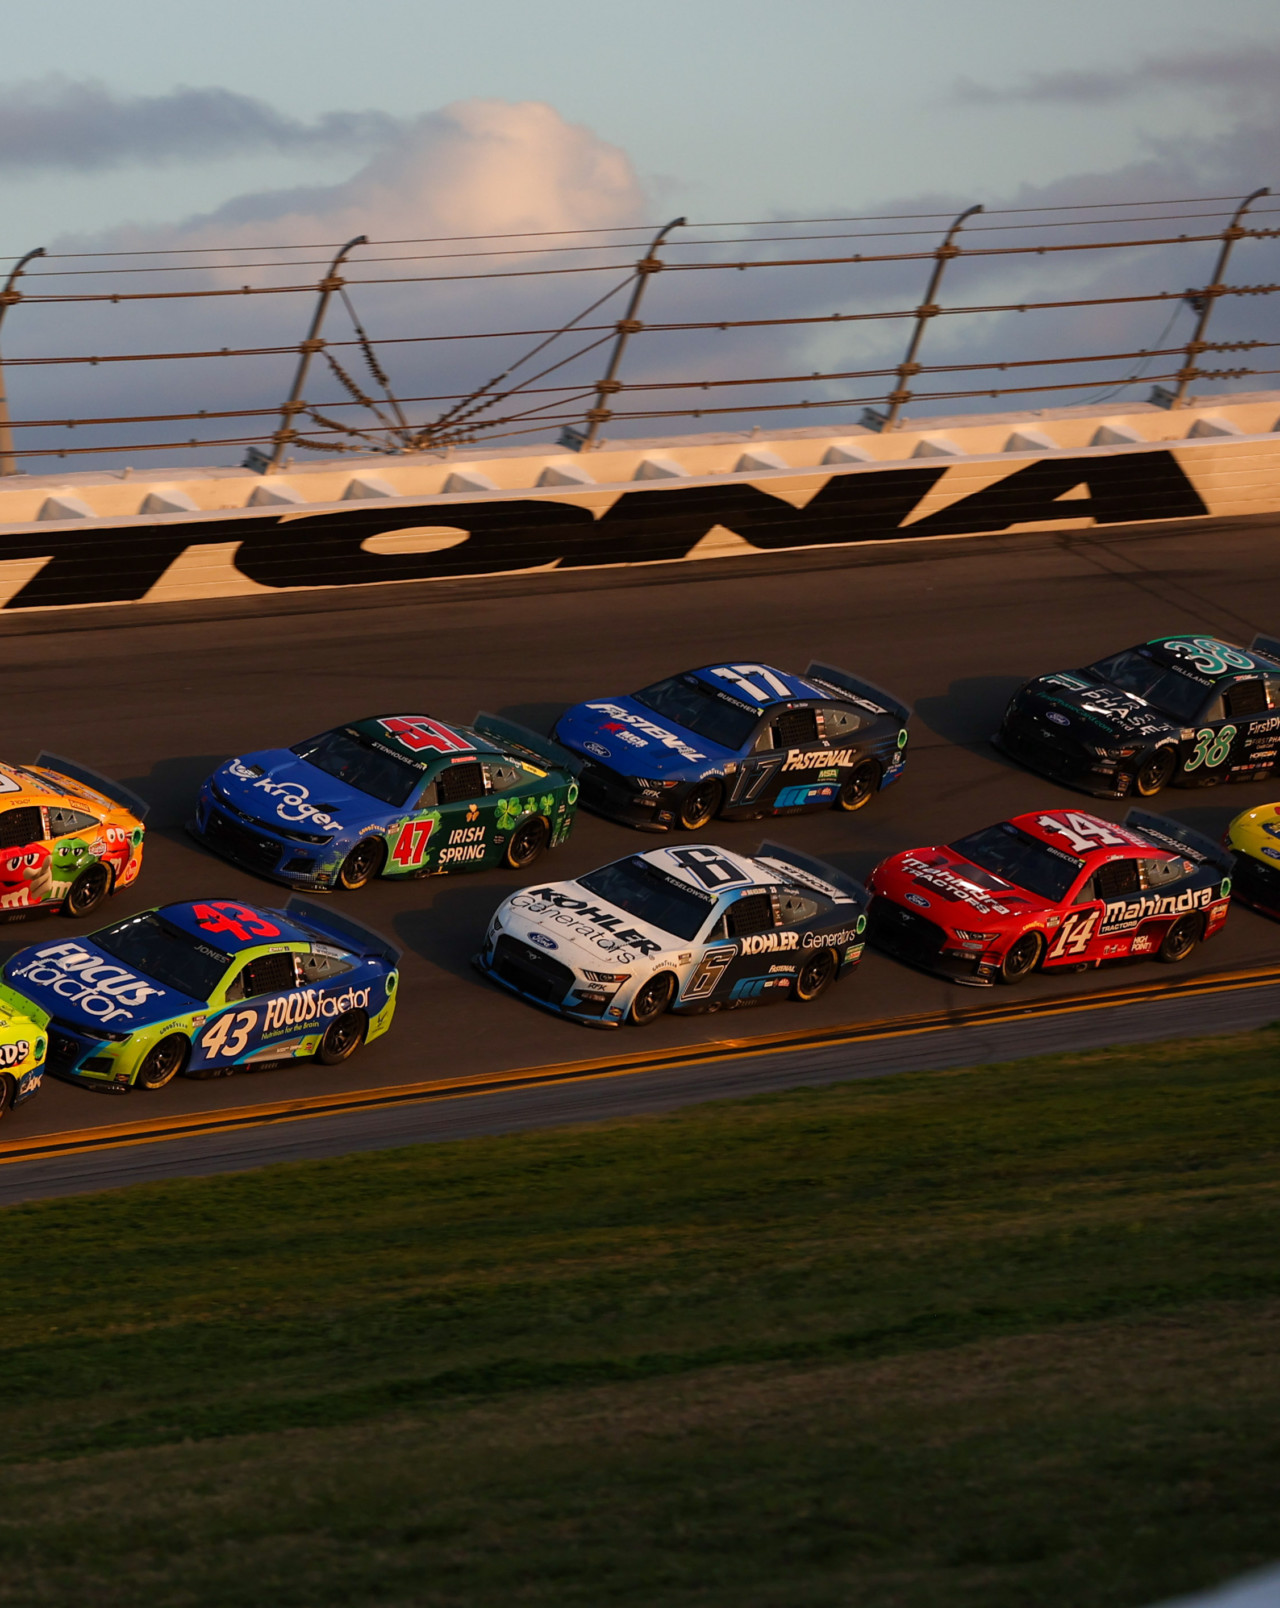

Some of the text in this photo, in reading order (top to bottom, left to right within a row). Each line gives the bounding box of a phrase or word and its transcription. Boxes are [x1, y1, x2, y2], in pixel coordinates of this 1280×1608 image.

[1164, 638, 1255, 675] 38
[1172, 665, 1211, 687] GILLILAND
[710, 664, 792, 703] 17
[717, 692, 757, 714] BUESCHER
[377, 716, 477, 754] 47
[1184, 725, 1238, 773] 38
[729, 756, 785, 803] 17
[781, 749, 855, 771] FASTENAL
[253, 777, 344, 831] Kroger
[392, 818, 435, 867] 47
[448, 826, 486, 845] IRISH
[1038, 812, 1126, 853] 14
[438, 843, 486, 864] SPRING
[1047, 847, 1079, 866] BRISCOE
[901, 866, 991, 915] TRACTORS
[191, 901, 281, 941] 43
[510, 895, 635, 964] Generators
[528, 887, 662, 957] KOHLER
[802, 929, 856, 949] Generators
[1048, 909, 1100, 959] 14
[1101, 920, 1139, 933] TRACTORS
[194, 945, 228, 963] JONES
[530, 933, 557, 949] Ford
[740, 931, 800, 957] KOHLER
[20, 958, 134, 1023] factor
[35, 942, 166, 1006] FOCUS
[679, 943, 739, 1002] 6
[201, 1010, 258, 1059] 43
[261, 1020, 320, 1041] Nutrition for the Brain
